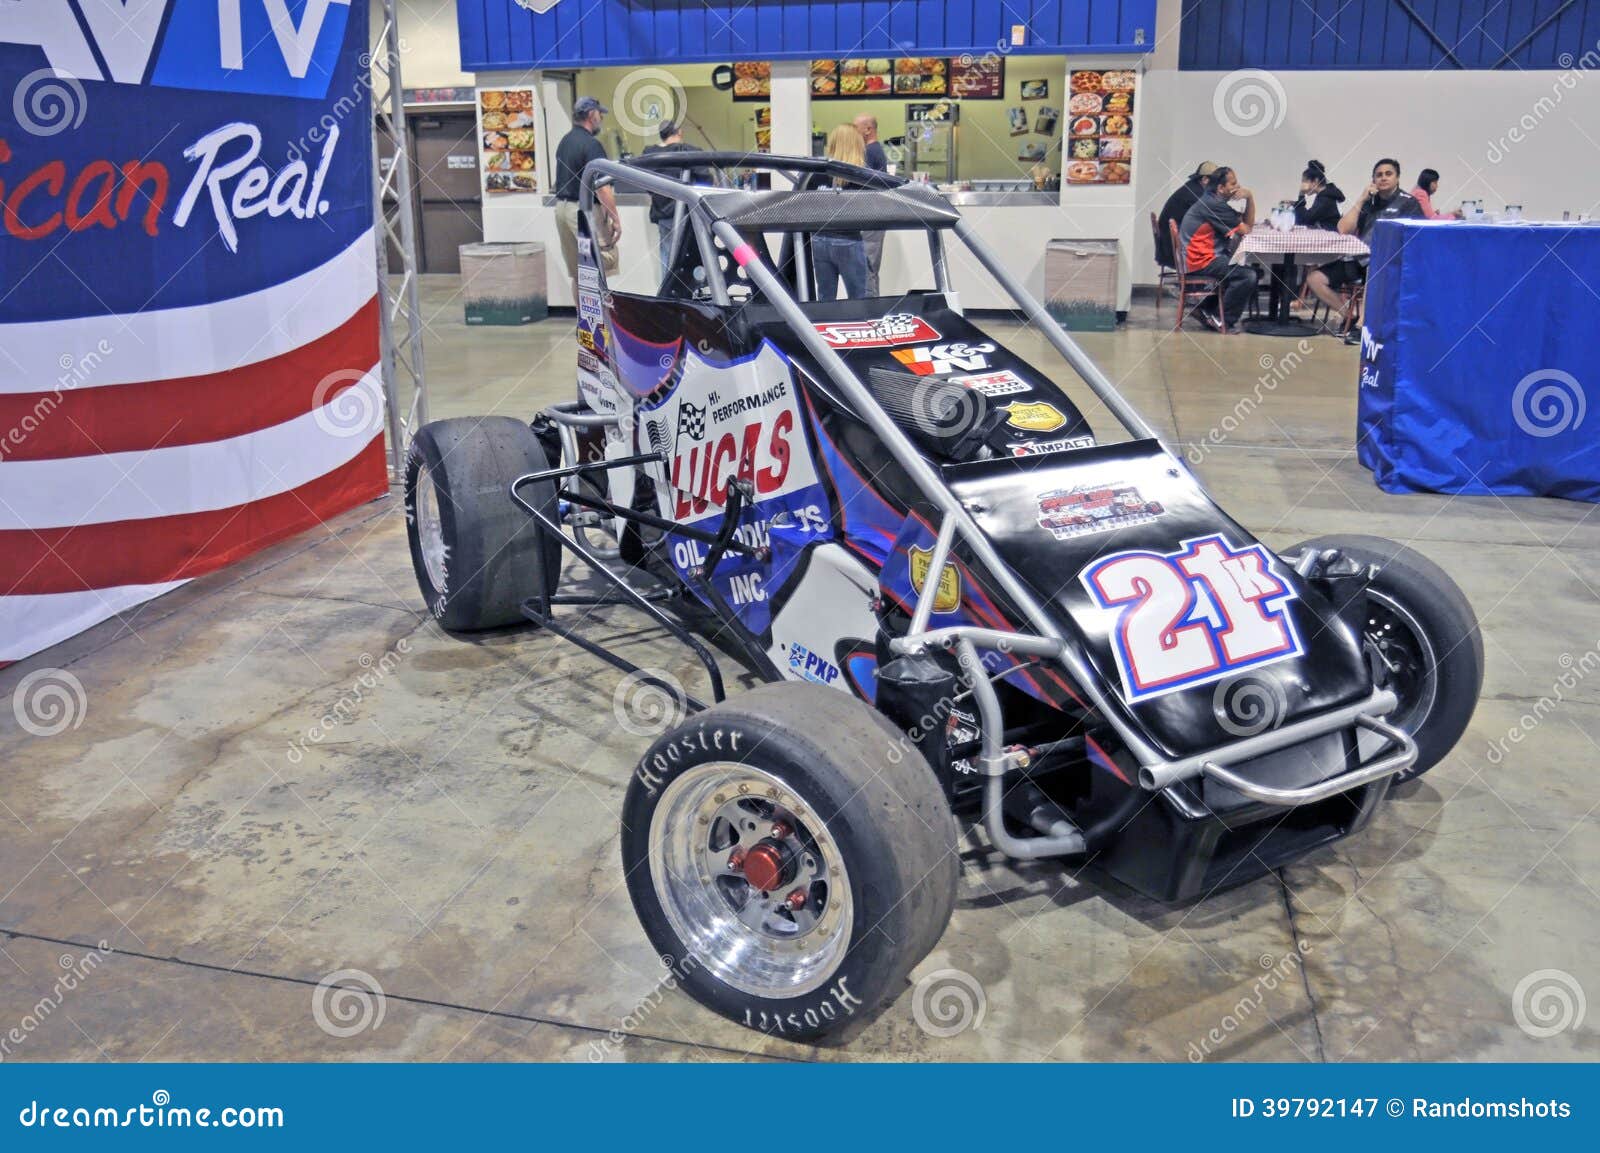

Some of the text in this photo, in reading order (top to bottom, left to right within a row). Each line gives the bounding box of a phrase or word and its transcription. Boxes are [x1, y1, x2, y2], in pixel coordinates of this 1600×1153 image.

[712, 382, 787, 425] PERFORMANCE
[671, 409, 794, 521] LUCAS
[1036, 439, 1091, 453] IMPACT
[674, 539, 706, 569] OIL
[636, 722, 744, 798] Hoosier
[742, 975, 863, 1032] Hoosier
